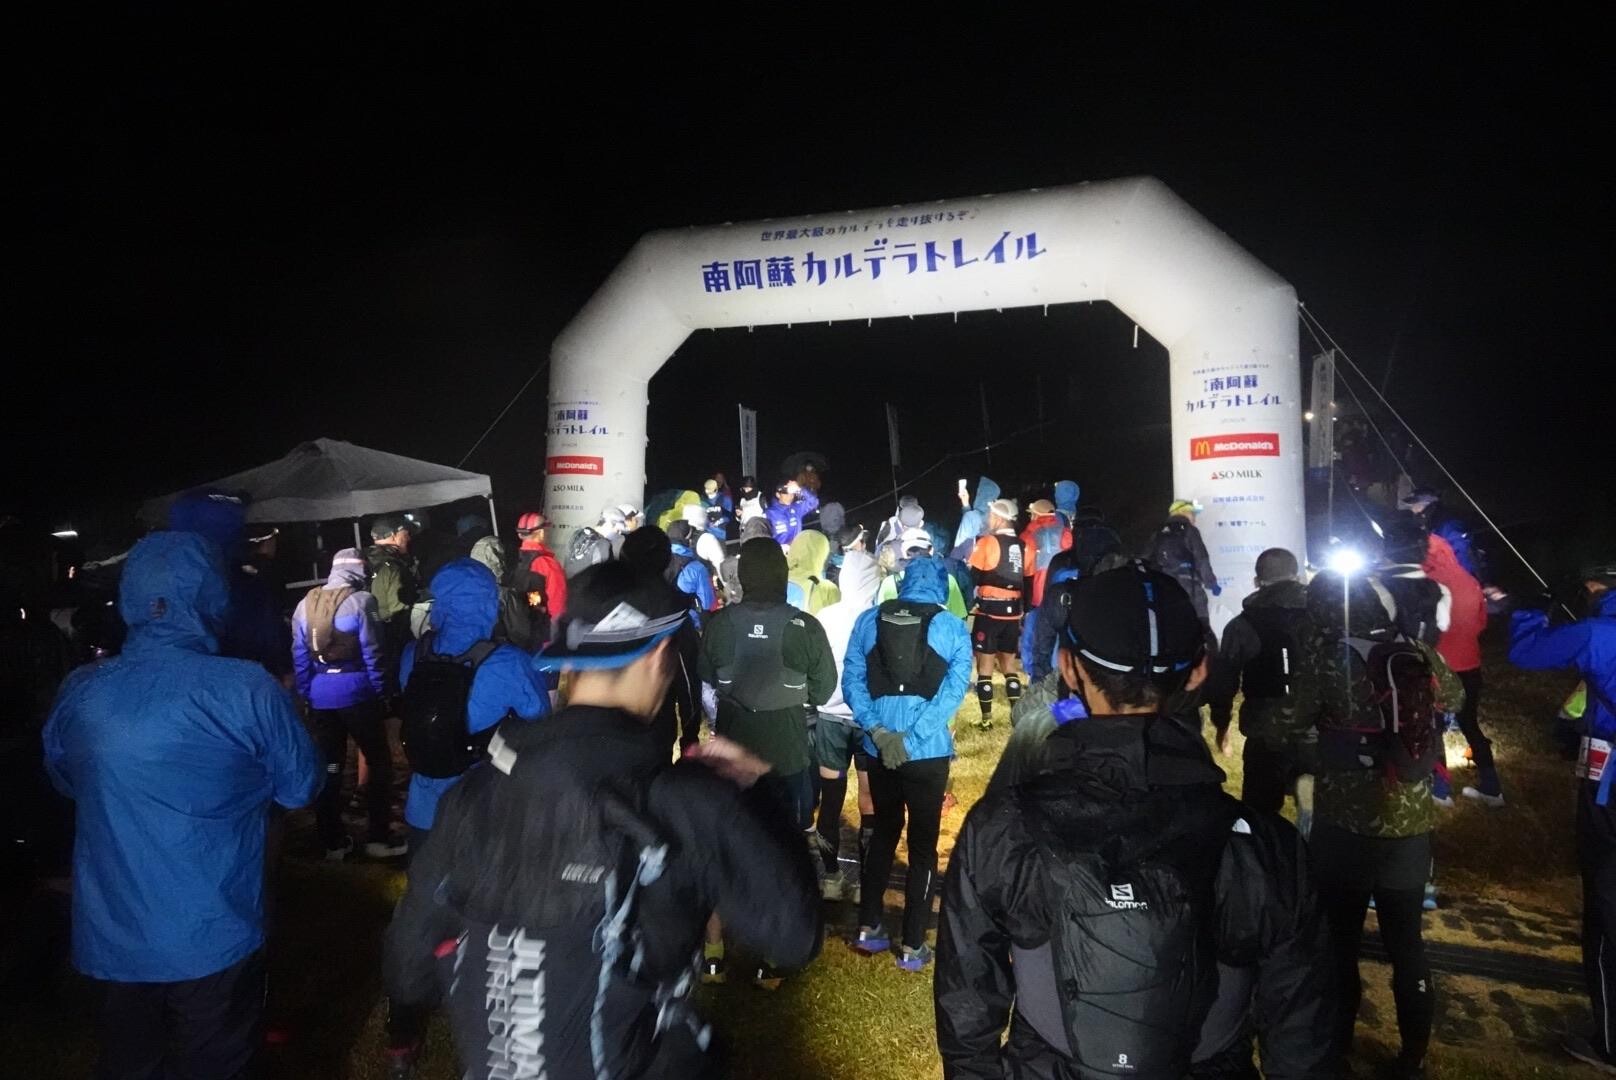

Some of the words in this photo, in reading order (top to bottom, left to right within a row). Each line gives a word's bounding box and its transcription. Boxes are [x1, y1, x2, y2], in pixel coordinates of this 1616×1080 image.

[702, 231, 1046, 292] 南阿蘇カルデラトレイル
[1236, 470, 1264, 479] MILK
[1118, 1053, 1128, 1065] 8
